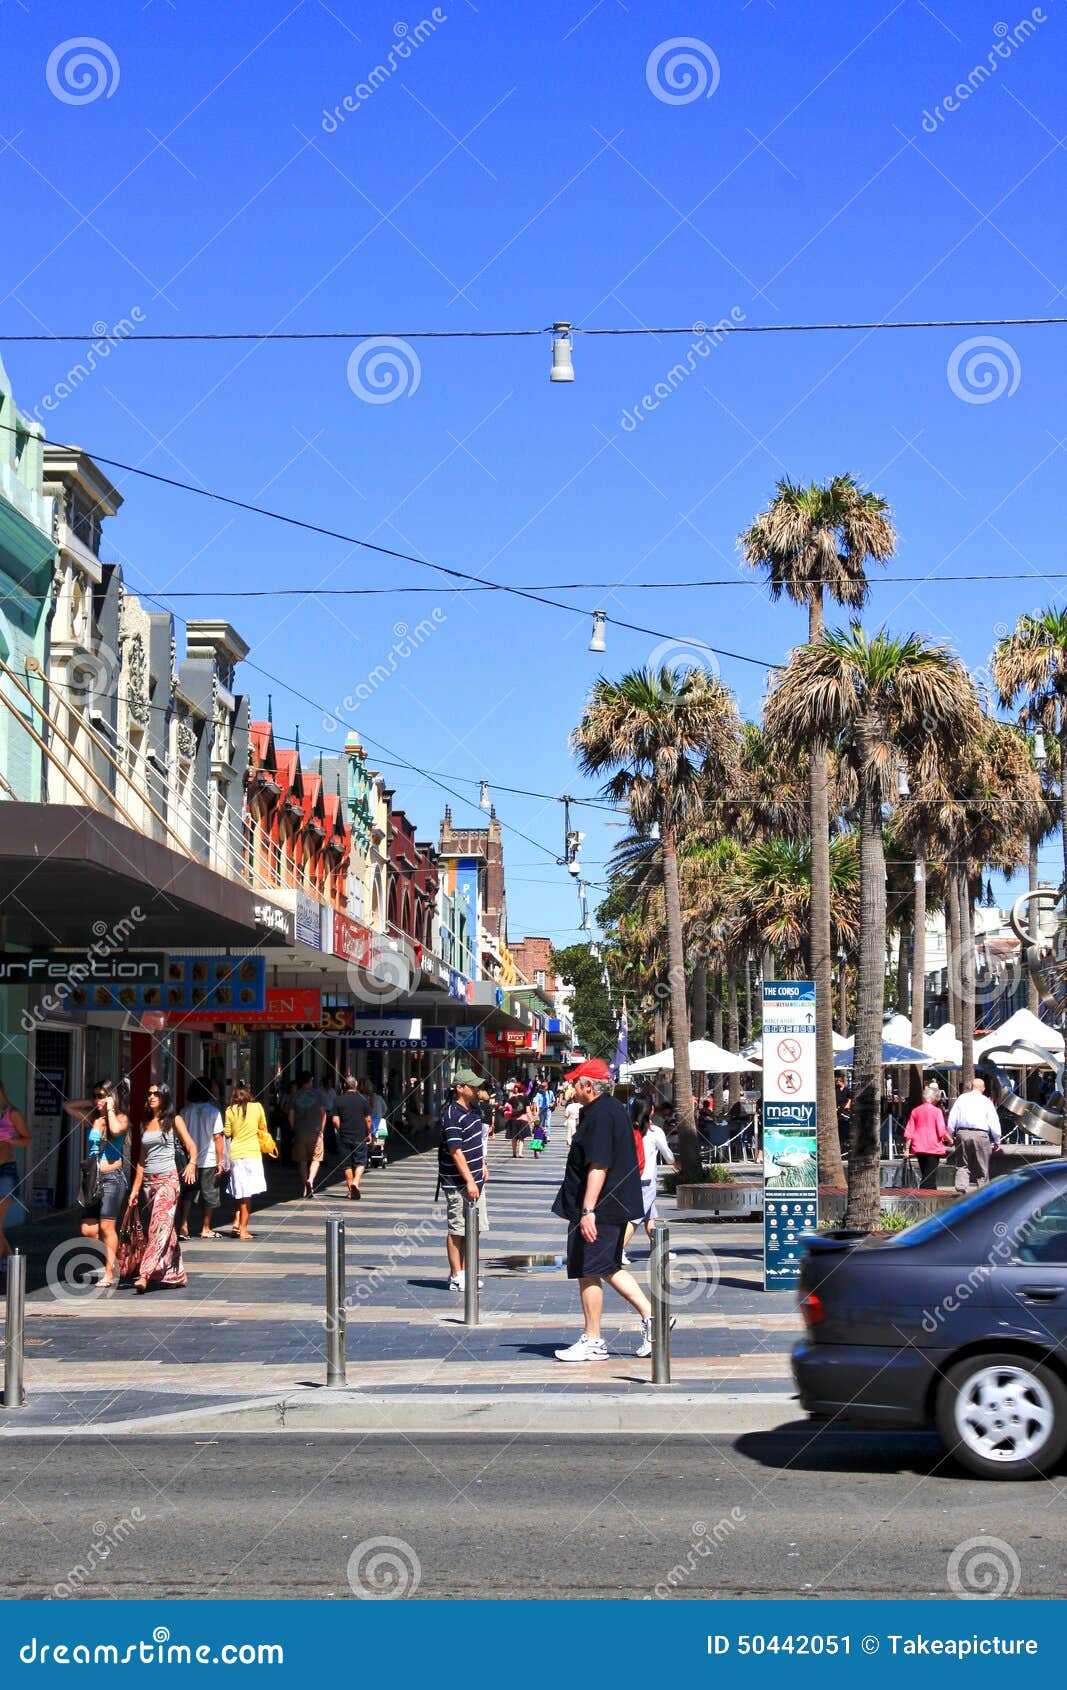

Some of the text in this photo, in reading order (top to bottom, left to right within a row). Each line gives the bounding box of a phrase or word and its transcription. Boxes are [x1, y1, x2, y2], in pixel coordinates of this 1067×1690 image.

[764, 987, 800, 996] THE CORSO
[363, 1029, 397, 1037] CURL
[366, 1040, 428, 1048] SEAFOOD
[766, 1104, 814, 1121] manly
